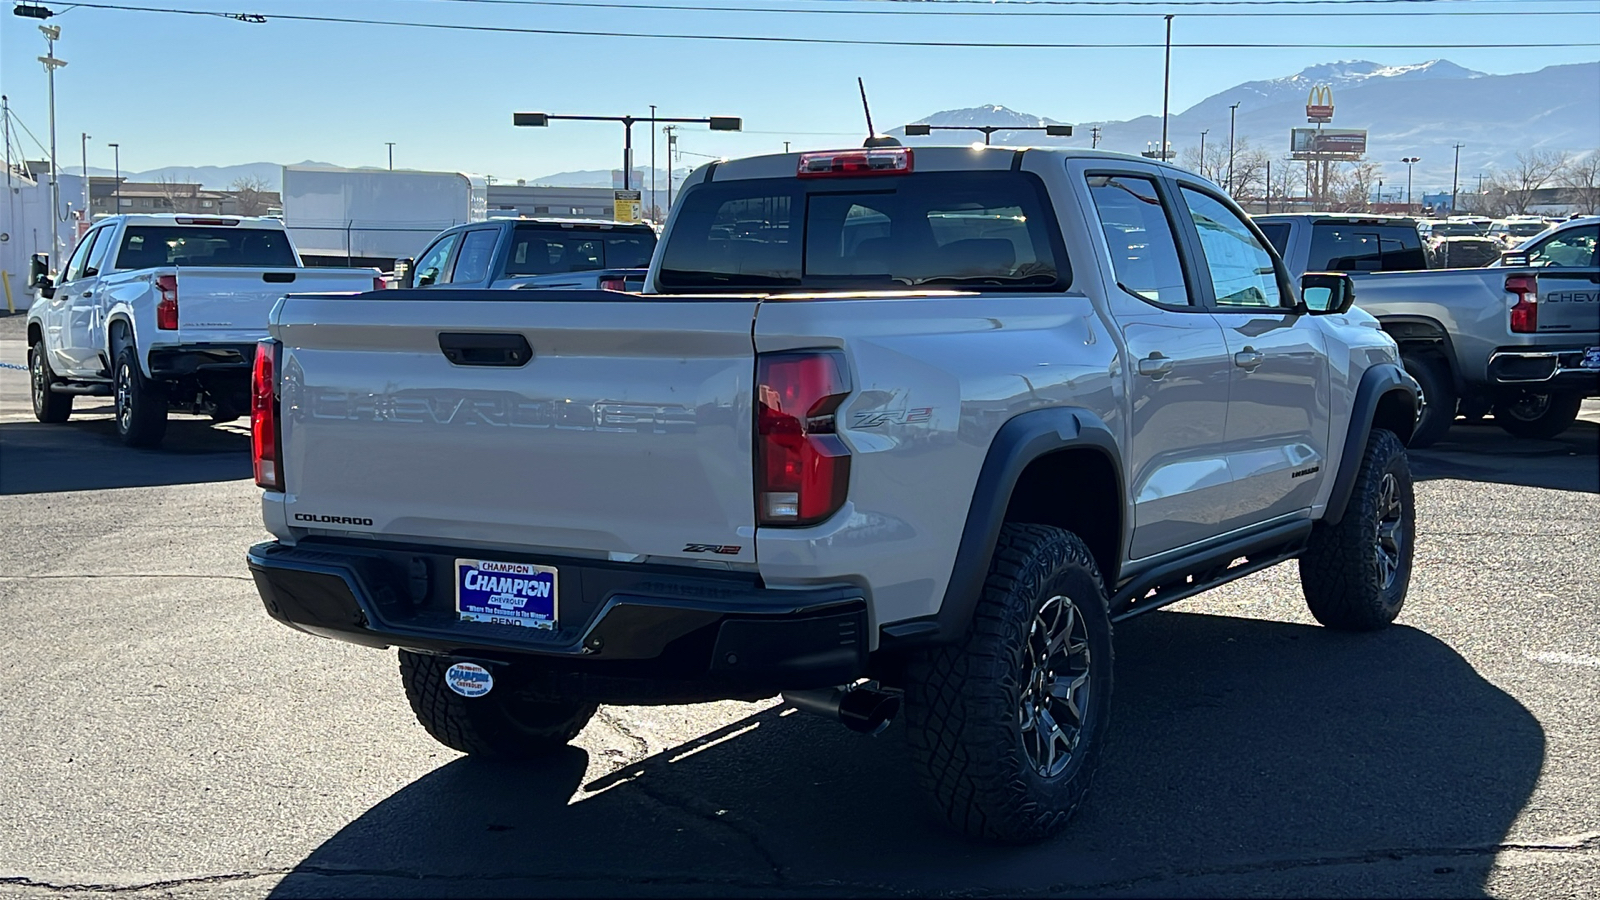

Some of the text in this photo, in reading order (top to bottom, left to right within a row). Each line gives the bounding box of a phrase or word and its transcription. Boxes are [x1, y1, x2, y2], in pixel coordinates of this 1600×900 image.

[1547, 292, 1600, 303] CHEV
[851, 407, 934, 429] ZR2
[294, 513, 373, 526] COLORADO
[682, 543, 742, 555] ZR2
[482, 562, 529, 574] CHAMPION
[464, 570, 551, 598] CHAMPION
[490, 596, 525, 606] CHEVROLET
[491, 617, 522, 627] RENO
